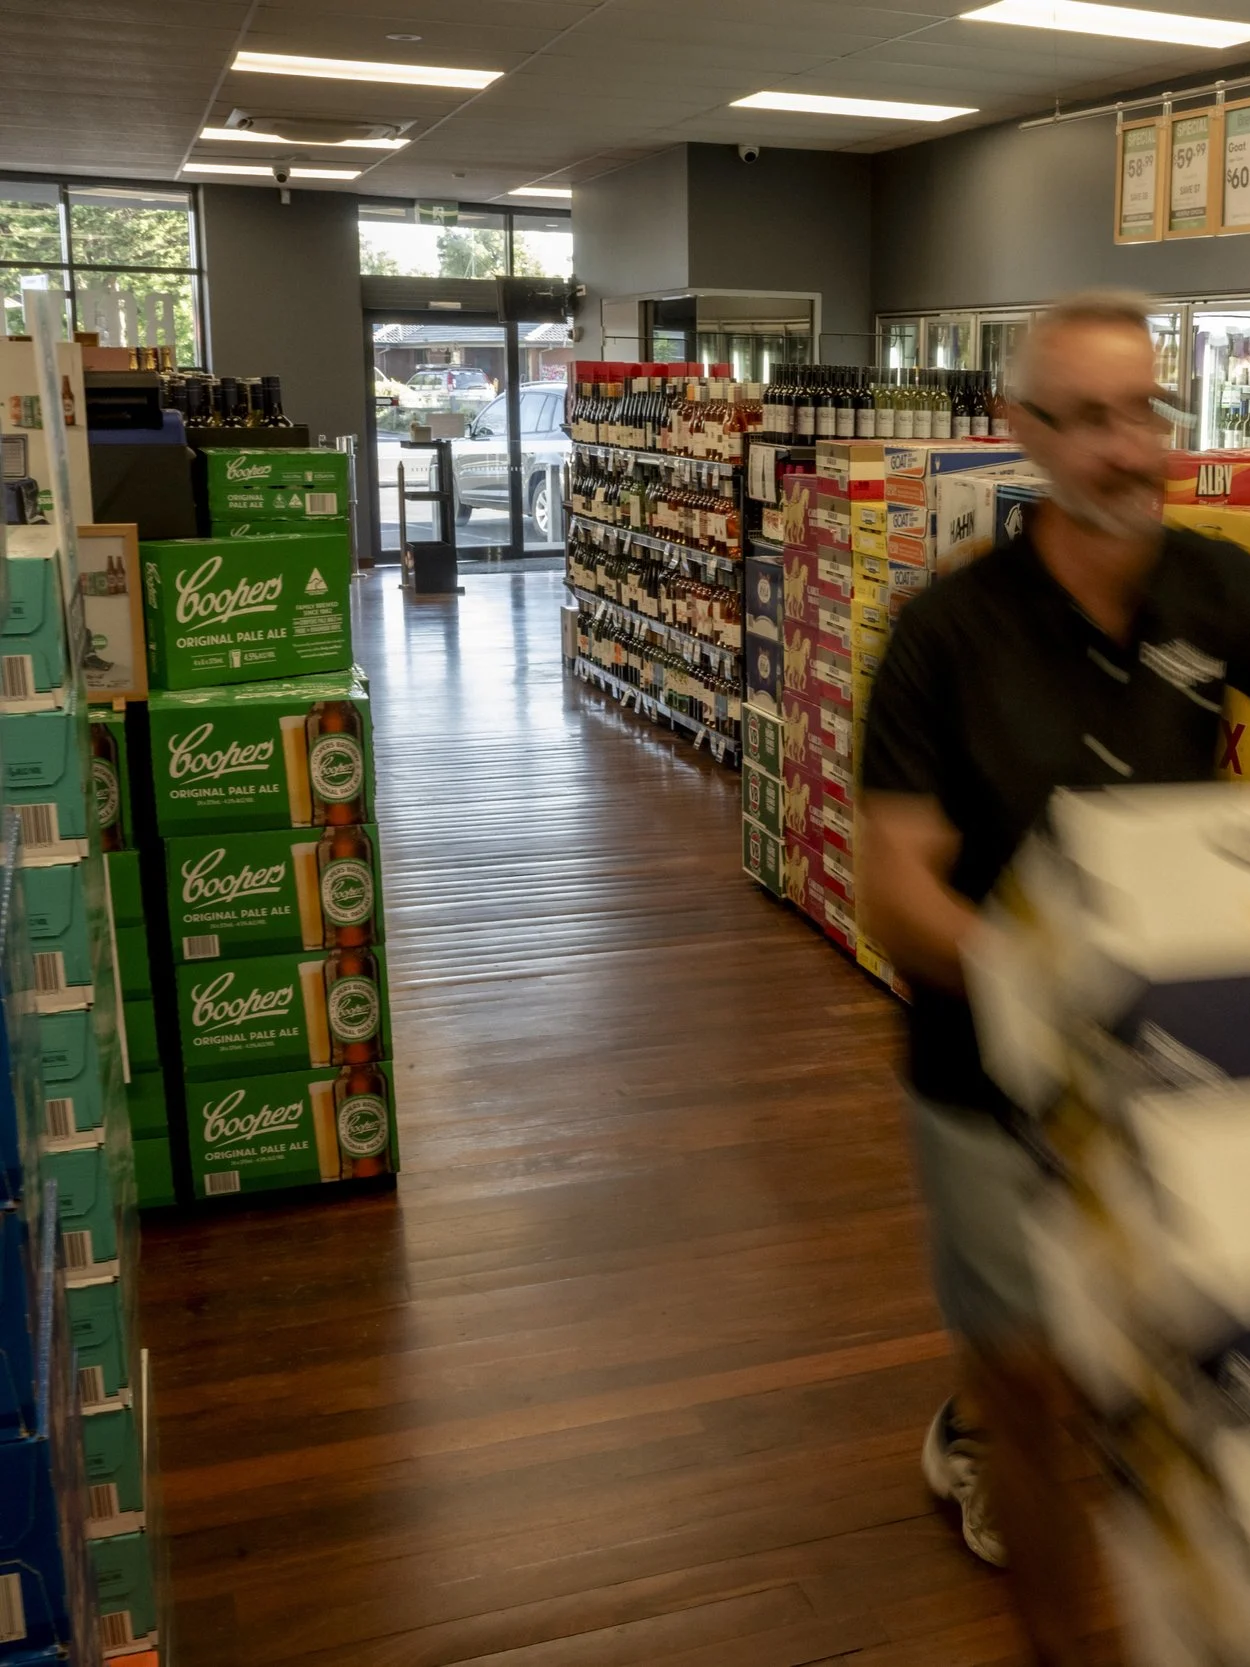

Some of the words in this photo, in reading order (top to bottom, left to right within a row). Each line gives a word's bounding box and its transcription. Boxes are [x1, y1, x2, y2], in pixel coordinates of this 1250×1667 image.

[1127, 132, 1156, 147] SPECIAL
[1177, 120, 1208, 138] SPECIAL
[1228, 142, 1247, 153] Goat
[226, 456, 272, 482] Coopers
[890, 453, 908, 470] GOAT
[1196, 465, 1233, 497] ALBY
[893, 511, 909, 528] GOAT
[949, 510, 975, 546] HAHN
[894, 570, 911, 586] GOAT
[175, 555, 283, 632] Coopers
[176, 632, 234, 649] ORIGINAL
[236, 630, 265, 643] PALE
[267, 627, 288, 640] ALE
[168, 723, 274, 786] Coopers
[170, 786, 225, 799] ORIGINAL
[228, 785, 256, 796] PALE
[259, 784, 280, 793] ALE
[181, 848, 286, 910] Coopers
[183, 910, 237, 923] ORIGINAL
[240, 908, 267, 918] PALE
[270, 906, 291, 915] ALE
[191, 972, 294, 1034] Coopers
[193, 1033, 247, 1046] ORIGINAL
[249, 1030, 276, 1041] PALE
[279, 1027, 300, 1038] ALE
[202, 1089, 304, 1148] Coopers
[204, 1148, 258, 1162] ORIGINAL
[260, 1144, 287, 1155] PALE
[289, 1141, 309, 1151] ALE
